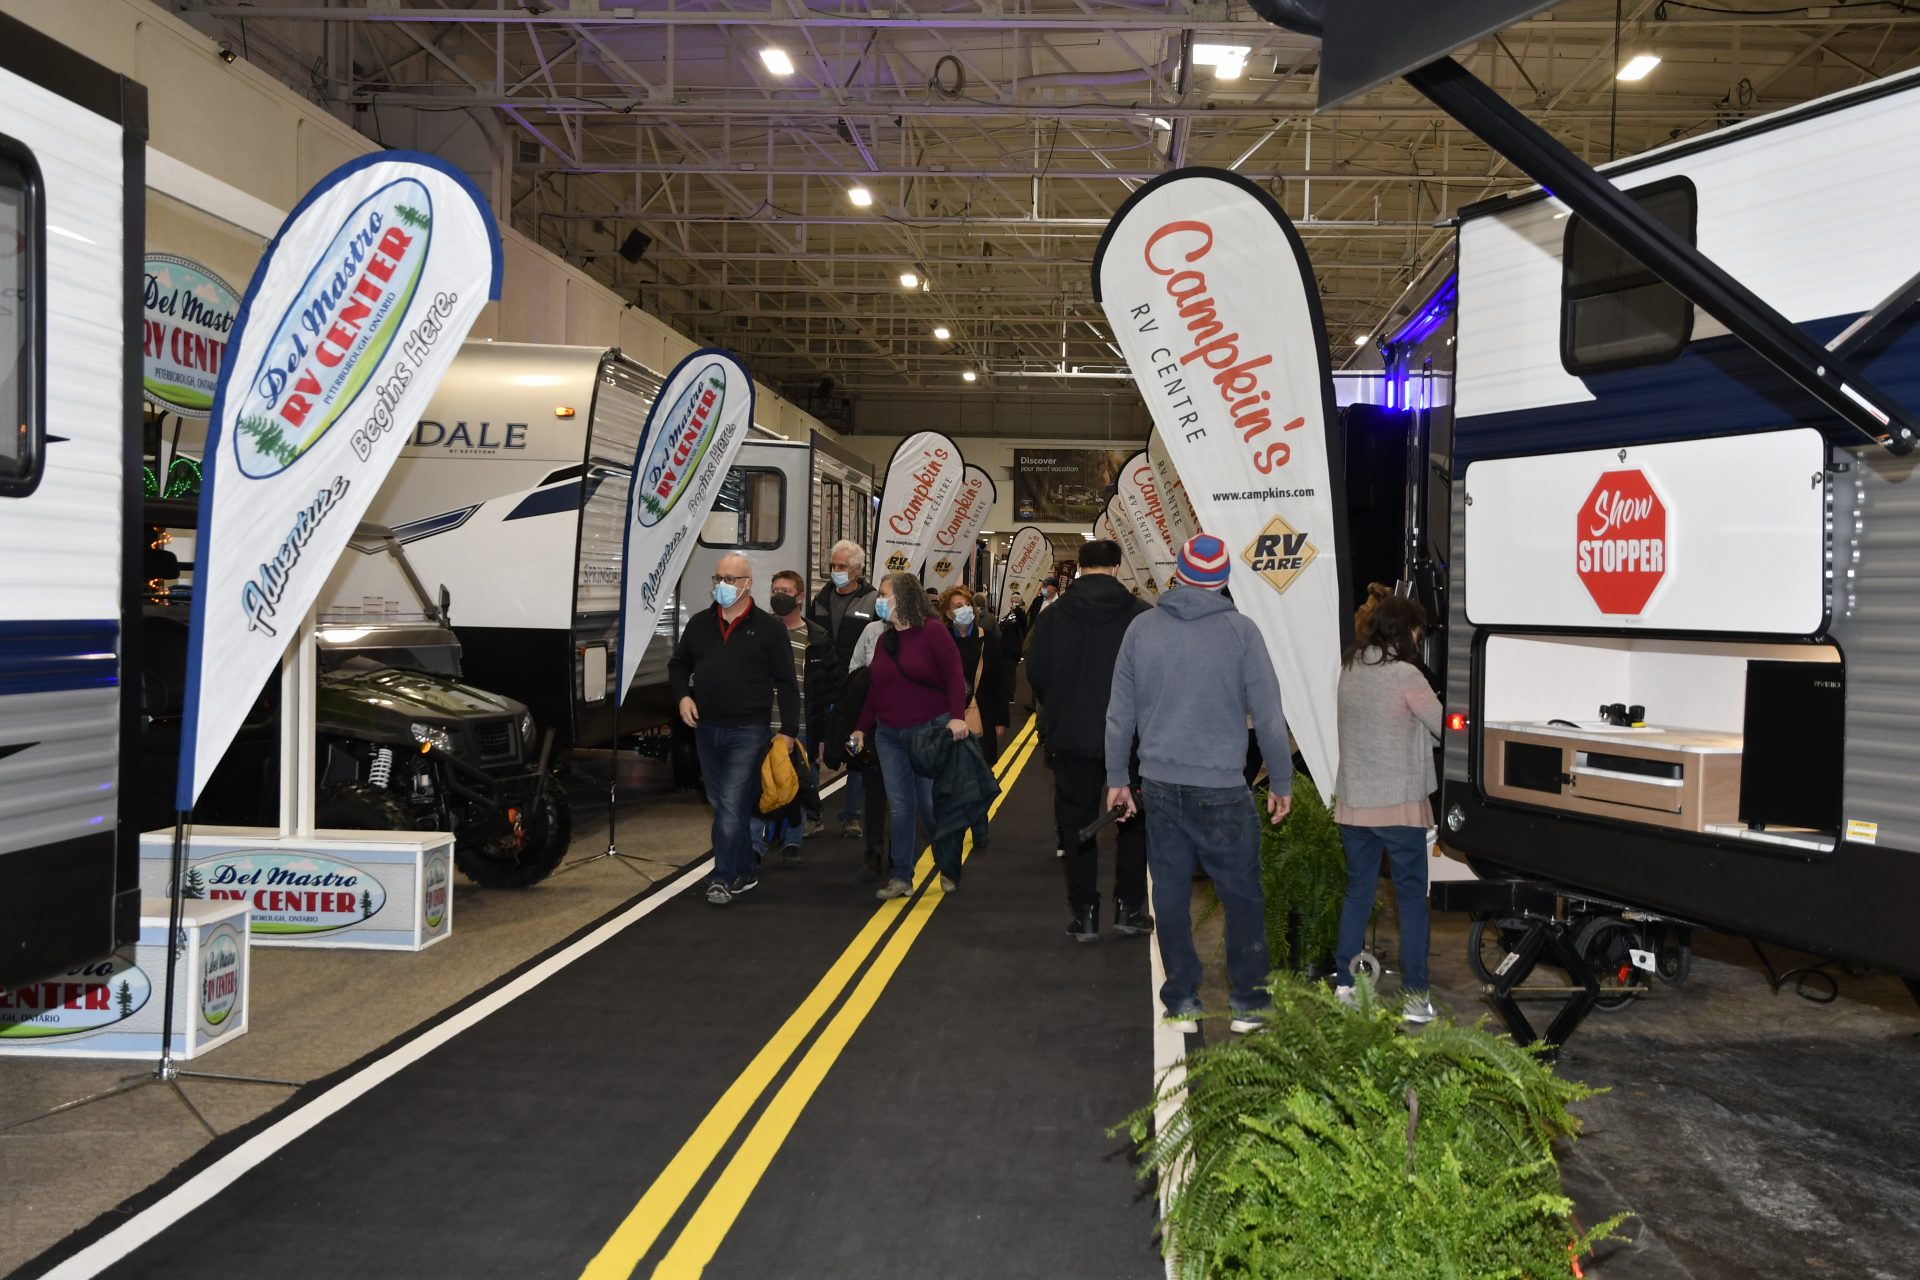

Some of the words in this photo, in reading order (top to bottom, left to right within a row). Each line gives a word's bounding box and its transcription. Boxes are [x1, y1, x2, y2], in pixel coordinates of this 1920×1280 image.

[144, 273, 178, 316] Del
[258, 333, 310, 410] Del
[302, 211, 384, 336] Mastro
[279, 368, 324, 429] RV
[315, 226, 413, 368] CENTER
[323, 336, 372, 405] PETERBOROUGH,
[370, 292, 396, 333] ONTARIO
[1144, 220, 1305, 475] Campkin's
[350, 361, 413, 463] Begins
[403, 291, 458, 368] Here.
[1130, 303, 1159, 333] RV
[1150, 348, 1207, 444] CENTRE
[405, 419, 529, 449] DALE
[649, 448, 670, 490] Del
[668, 382, 704, 449] Mastro
[656, 467, 677, 499] RV
[673, 389, 717, 467] CENTER
[709, 422, 737, 471] Here.
[1020, 456, 1057, 465] Discover
[888, 447, 949, 536] Campkin's
[923, 514, 933, 527] RV
[931, 476, 952, 512] CENTRE
[936, 478, 983, 546] Campkin's
[968, 500, 987, 527] CENTRE
[1157, 460, 1168, 476] RV
[1163, 480, 1182, 527] CENTRE
[1212, 486, 1315, 502] www.campkins.com
[1590, 490, 1653, 537] Show
[1120, 529, 1136, 556] CENTRE
[1128, 494, 1138, 507] RV
[1134, 510, 1154, 545] CENTRE
[242, 475, 350, 637] Adventure
[888, 556, 909, 566] RV
[936, 561, 952, 569] RV
[1250, 556, 1304, 572] CARE
[1255, 532, 1309, 558] RV
[1578, 538, 1664, 573] STOPPER
[209, 864, 263, 885] Del
[267, 867, 358, 888] Mastro
[253, 889, 356, 913] CENTER
[288, 915, 319, 923] ONTARIO
[20, 1014, 60, 1023] ONTARIO
